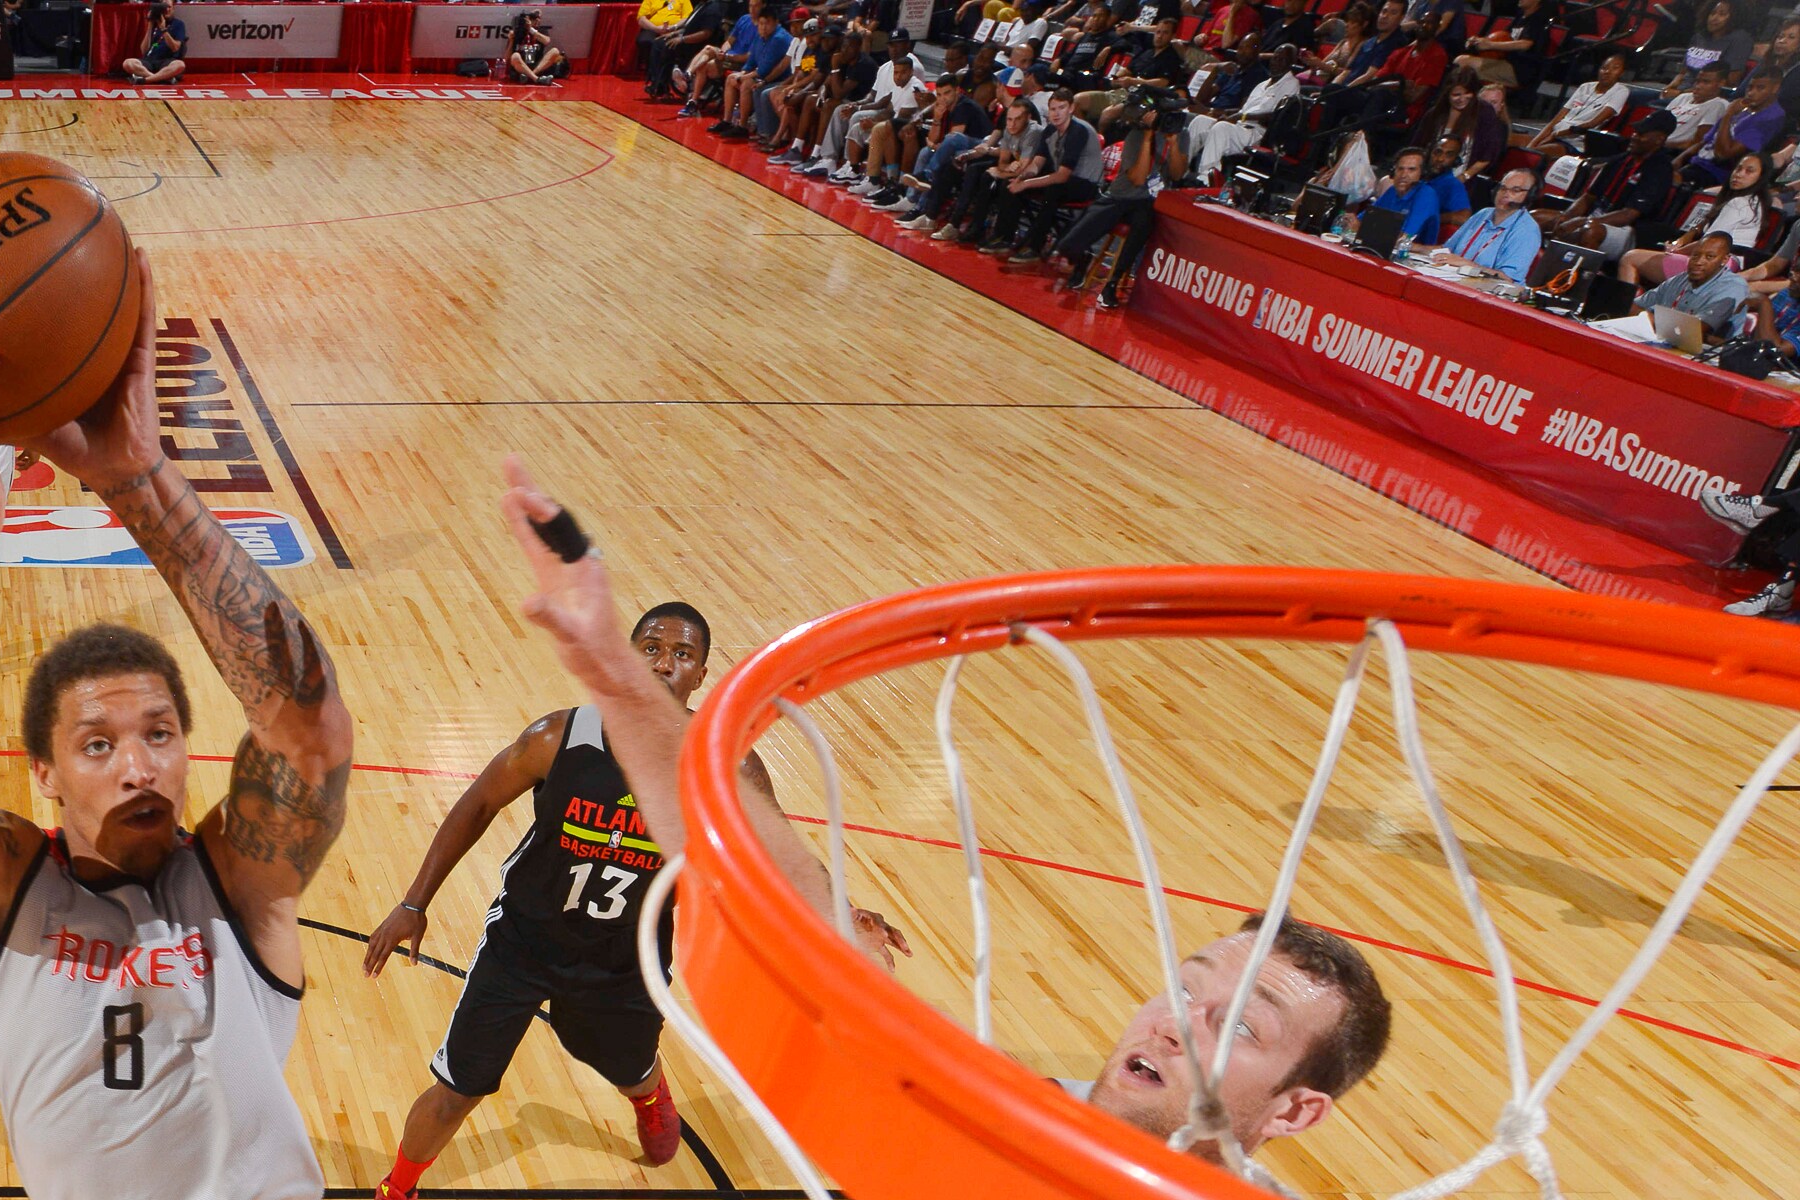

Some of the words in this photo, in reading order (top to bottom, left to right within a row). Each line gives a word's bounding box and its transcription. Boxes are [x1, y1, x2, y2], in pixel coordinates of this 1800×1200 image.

[208, 20, 285, 41] verizon
[247, 88, 514, 101] LEAGUE
[1146, 247, 1254, 318] SAMSUNG
[1264, 291, 1314, 346] NBA
[1311, 313, 1426, 390] SUMMER
[1417, 355, 1534, 434] LEAGUE
[564, 796, 648, 836] ATLAN
[562, 862, 639, 920] 13
[102, 1001, 146, 1091] 8
